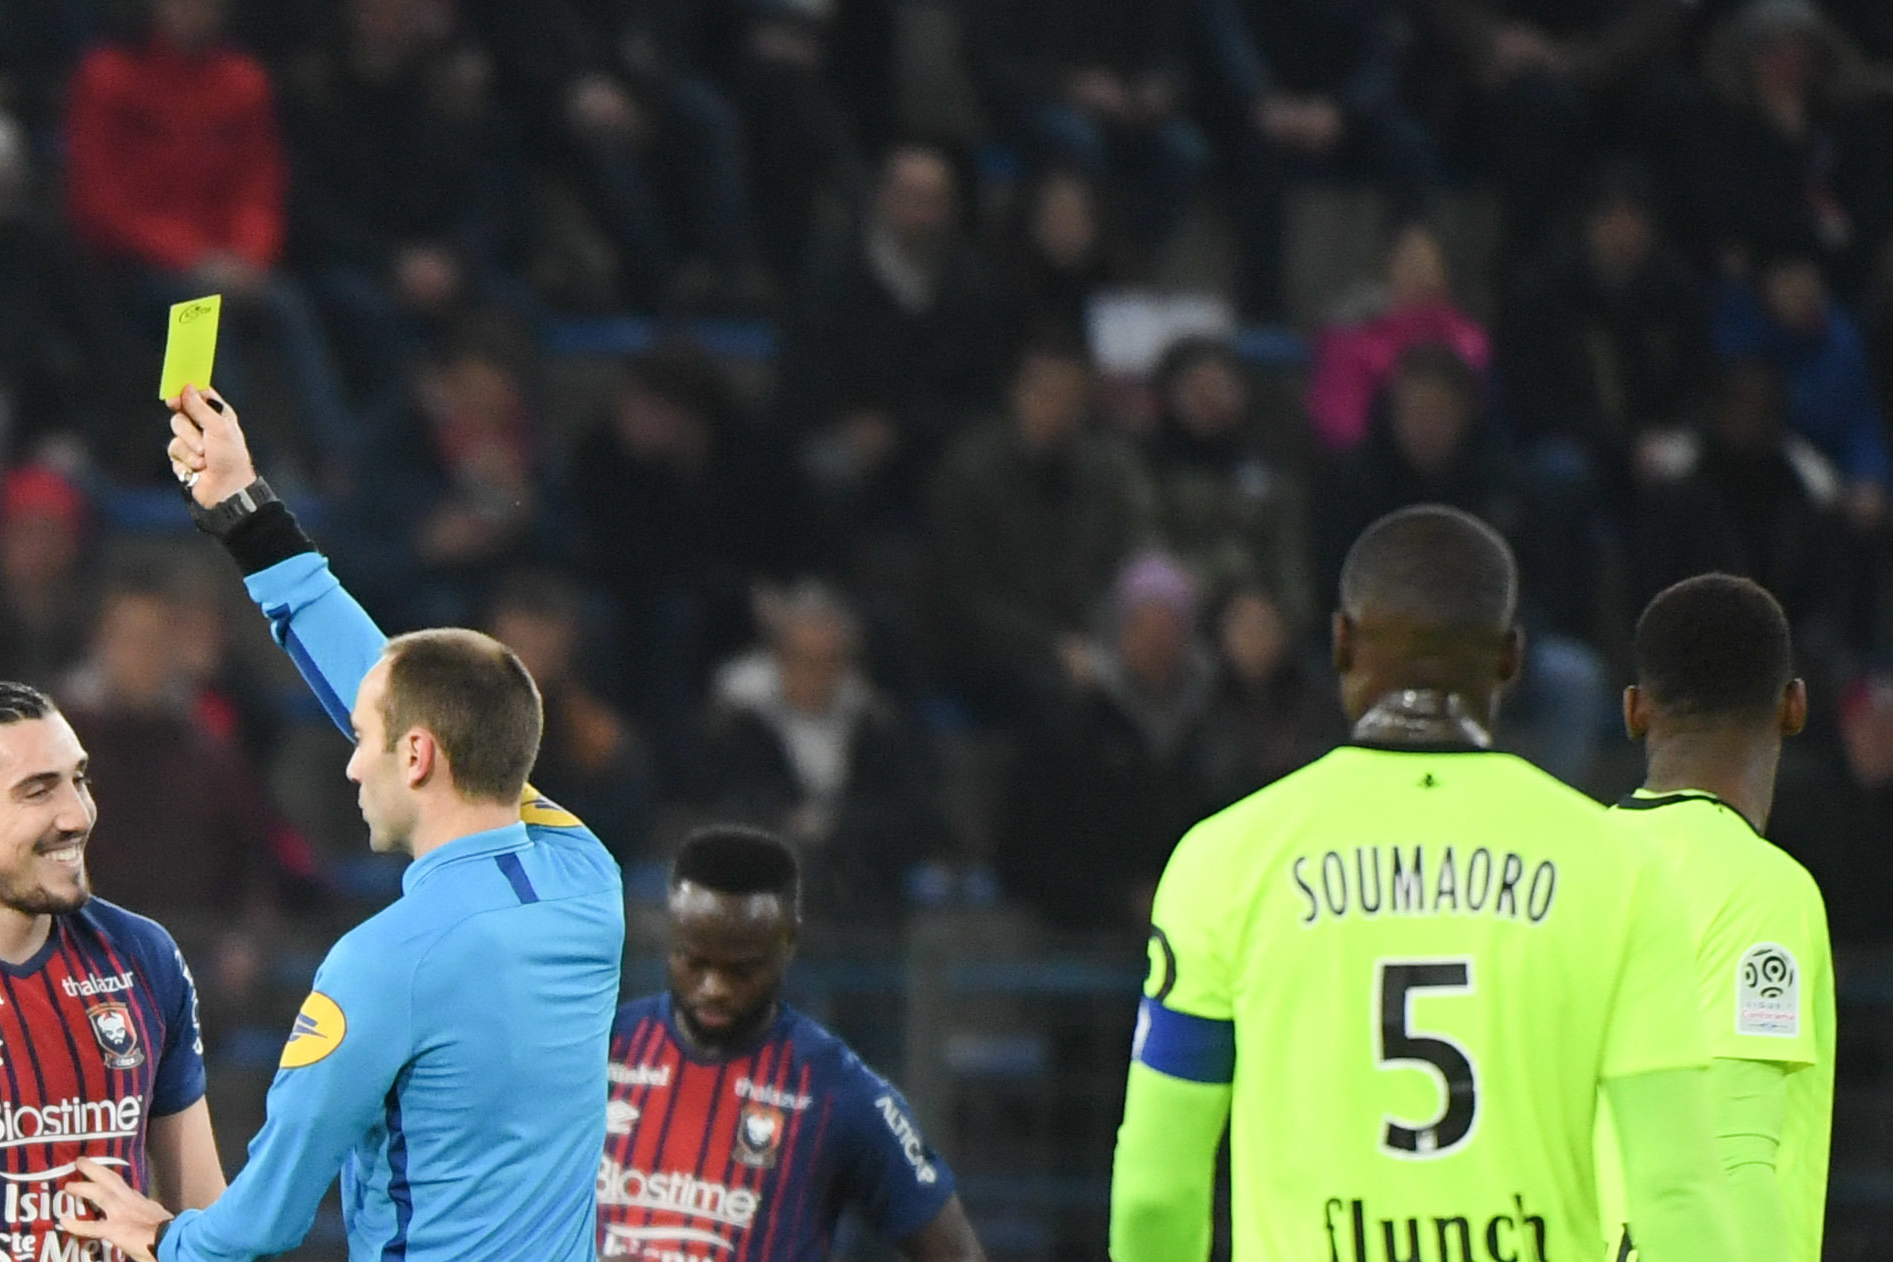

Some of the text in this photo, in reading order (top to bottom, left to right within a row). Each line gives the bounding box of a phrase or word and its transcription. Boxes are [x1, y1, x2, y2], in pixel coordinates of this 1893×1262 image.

[1292, 844, 1559, 923] SOUMAORO
[62, 970, 137, 998] thalazur
[1376, 957, 1480, 1159] 5
